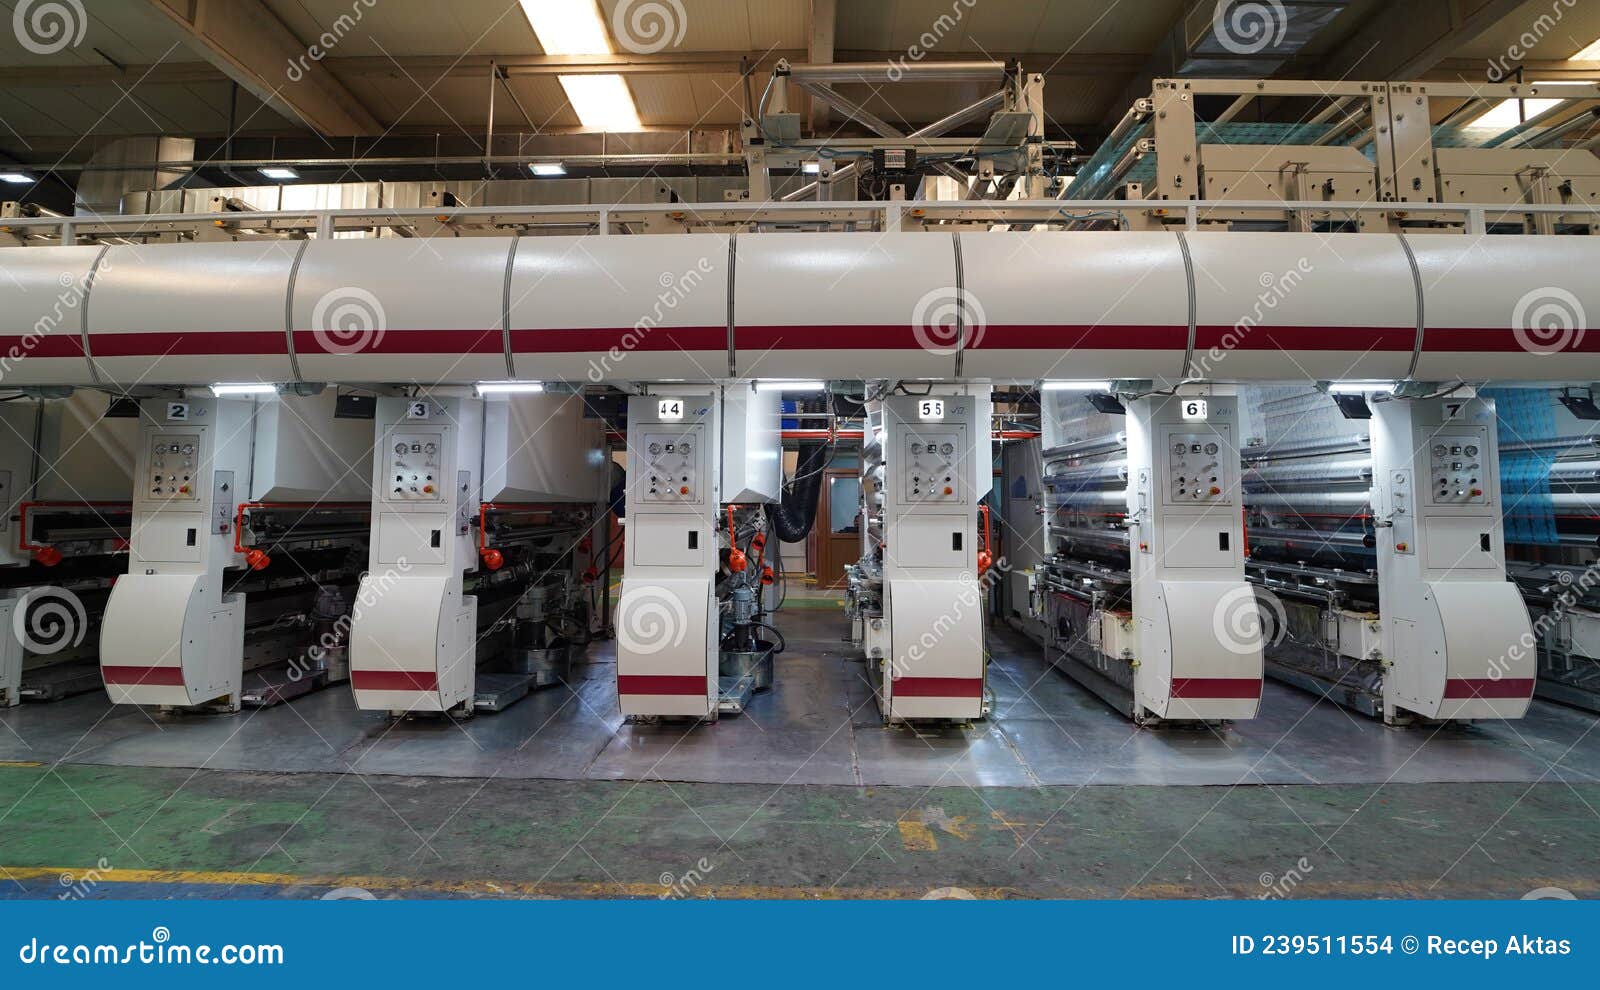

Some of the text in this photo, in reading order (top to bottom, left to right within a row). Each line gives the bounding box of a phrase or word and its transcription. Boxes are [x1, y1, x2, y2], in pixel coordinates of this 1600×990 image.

[172, 405, 185, 417] 2
[414, 404, 426, 416] 3
[1186, 403, 1198, 415] 6
[1446, 404, 1461, 417] 7
